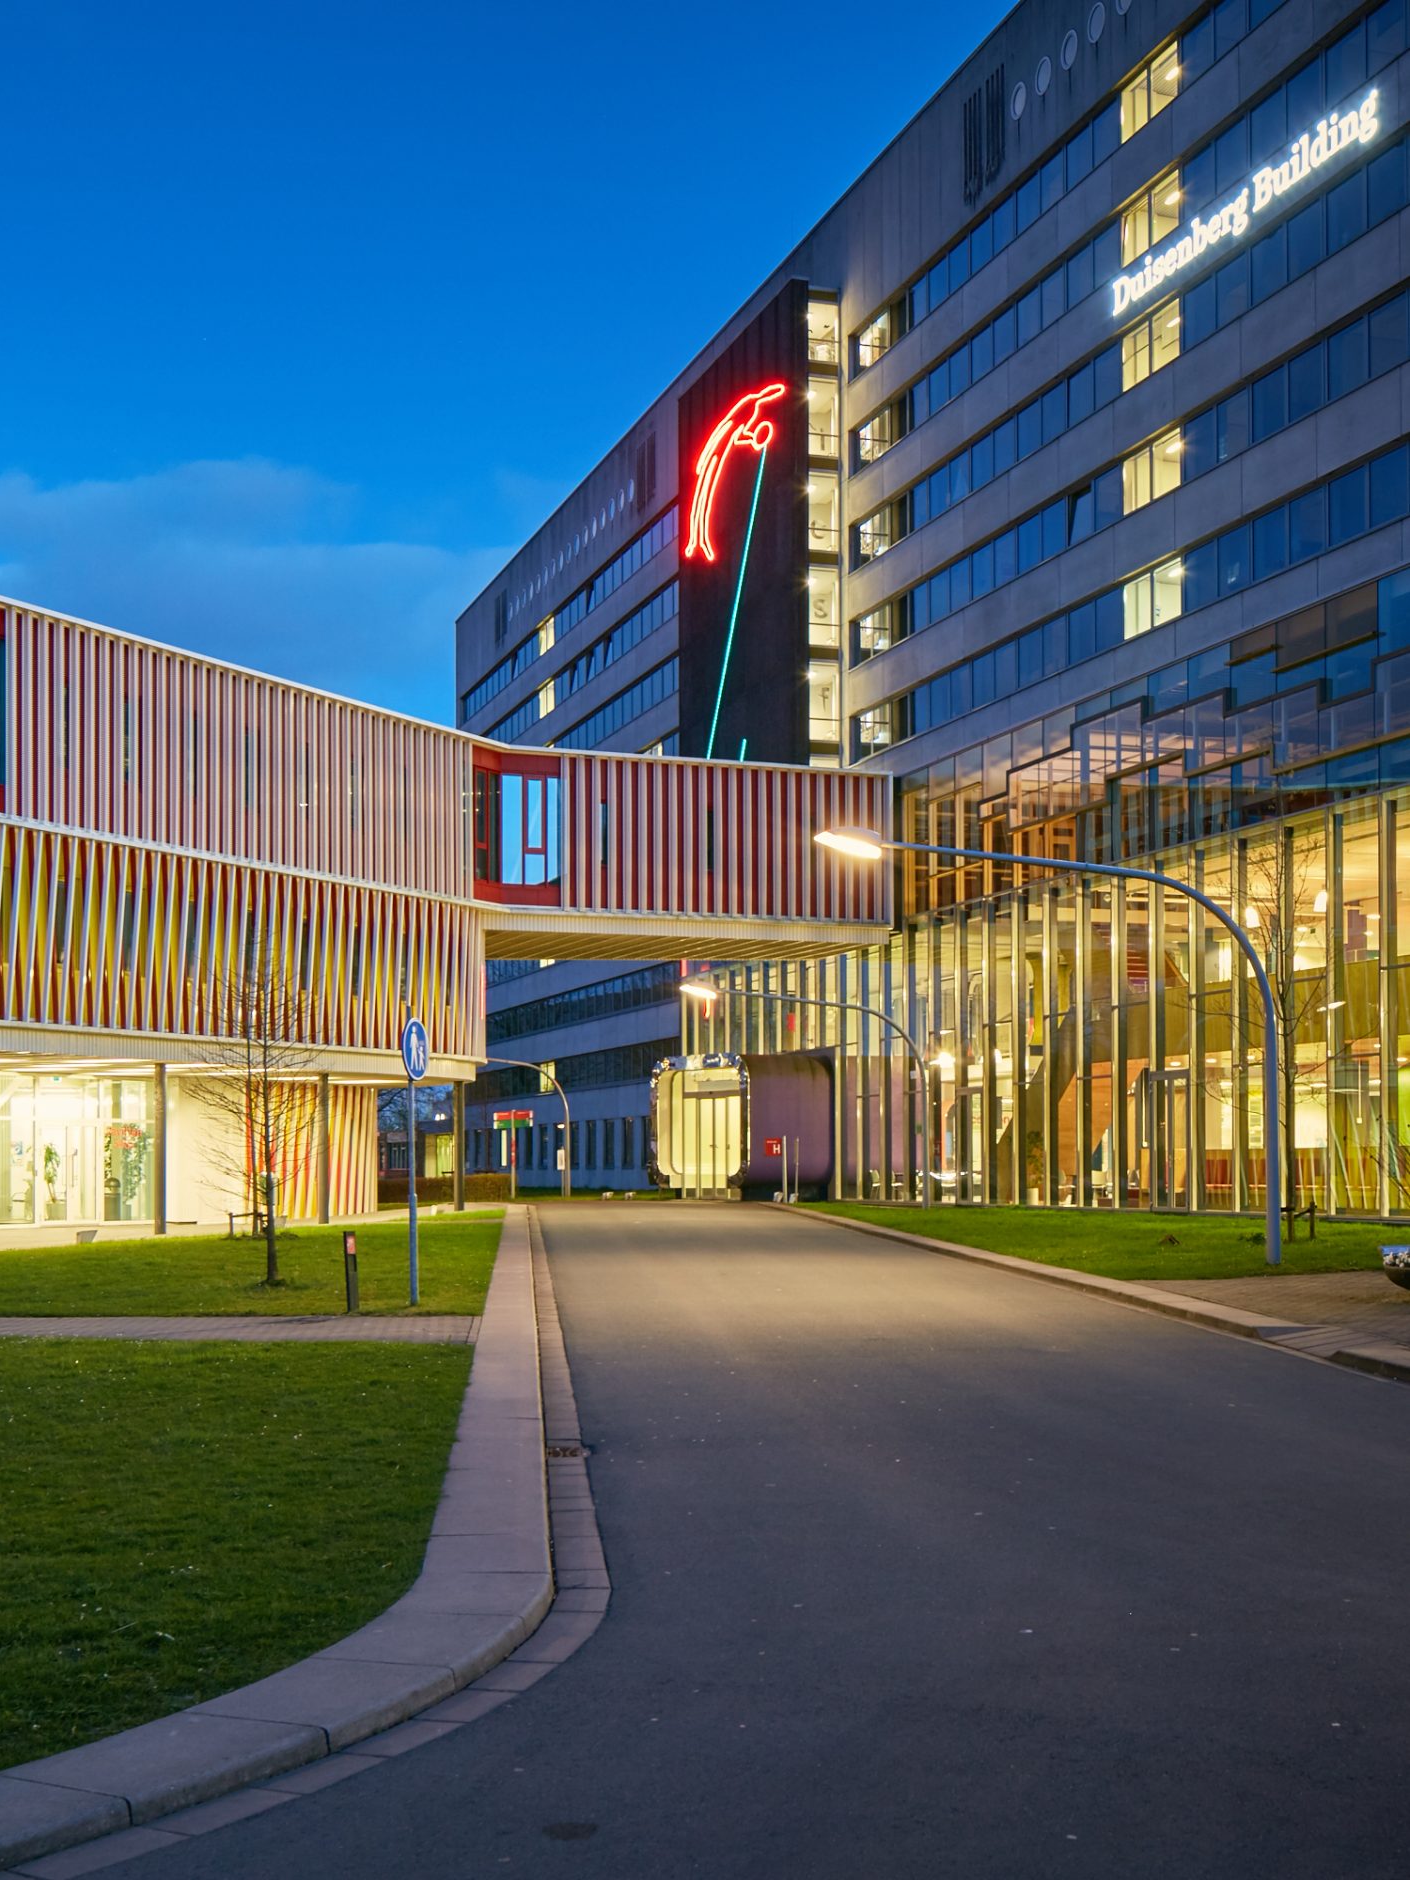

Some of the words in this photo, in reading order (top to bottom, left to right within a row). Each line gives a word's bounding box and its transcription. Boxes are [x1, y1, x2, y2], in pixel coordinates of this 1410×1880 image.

[1112, 188, 1248, 315] Duisenberg
[1252, 88, 1378, 212] Building
[773, 1144, 781, 1154] H
